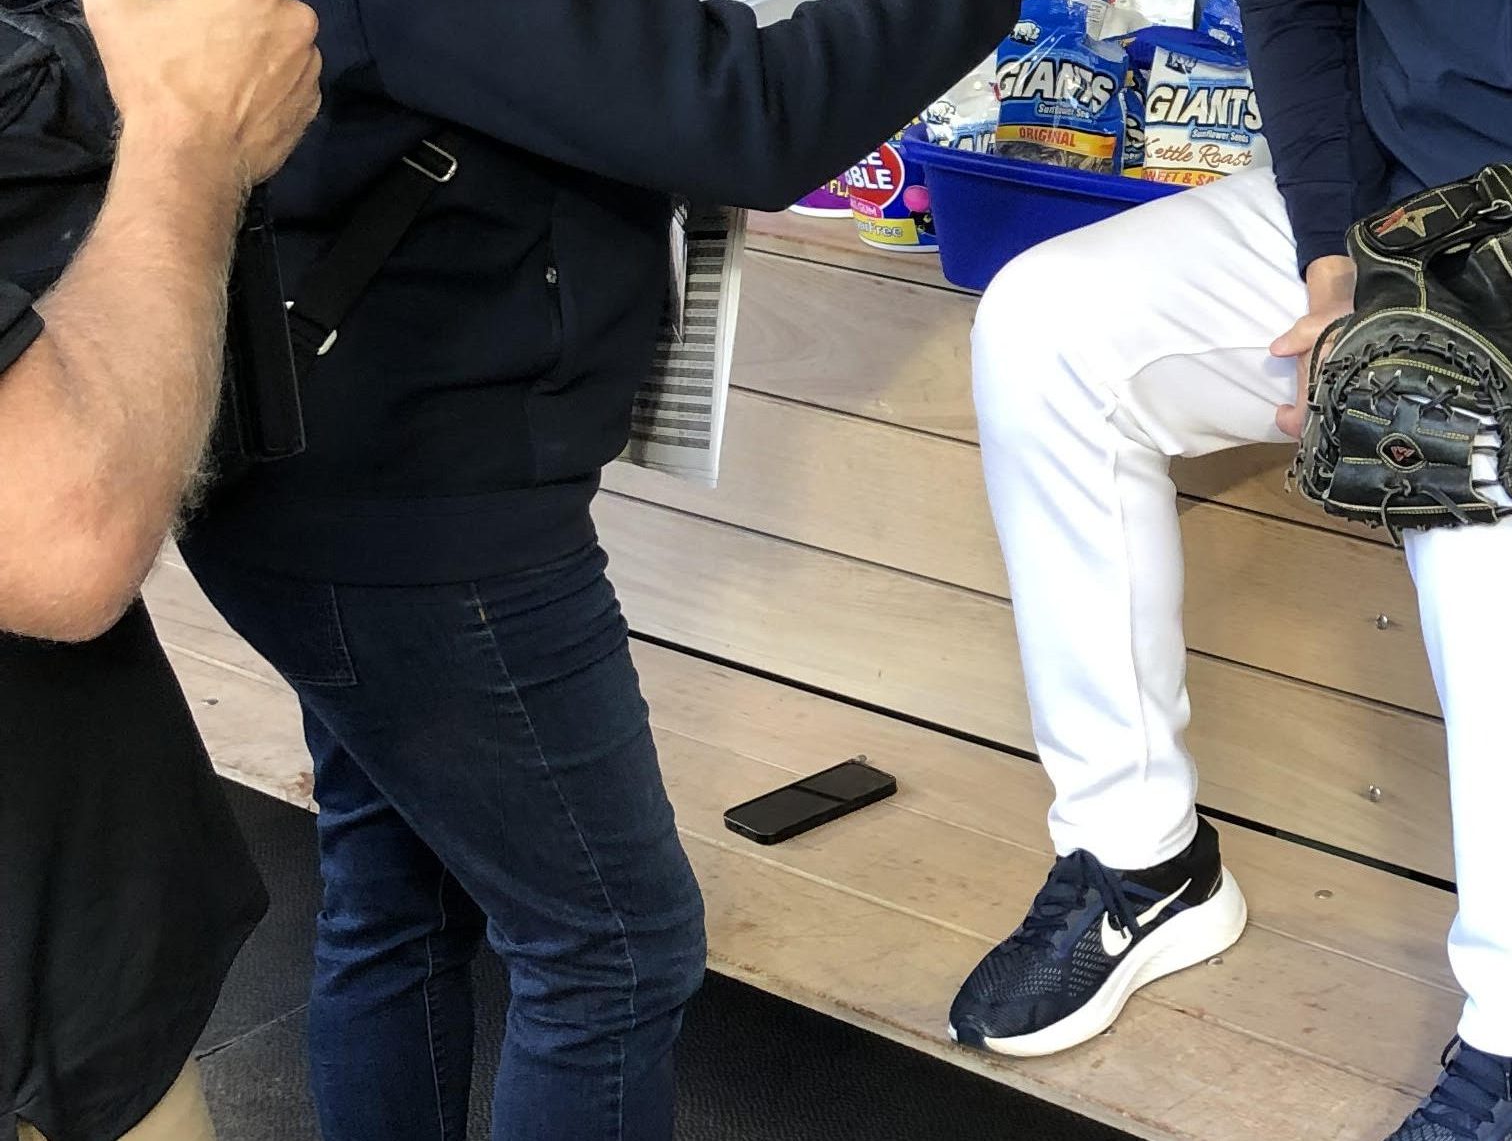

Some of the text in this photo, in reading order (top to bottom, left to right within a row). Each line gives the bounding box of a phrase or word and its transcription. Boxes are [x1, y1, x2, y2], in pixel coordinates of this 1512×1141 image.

[996, 60, 1115, 114] GIANTS
[1145, 85, 1263, 131] GIANTS
[1018, 126, 1077, 148] ORIGINAL
[1198, 143, 1253, 169] Roast
